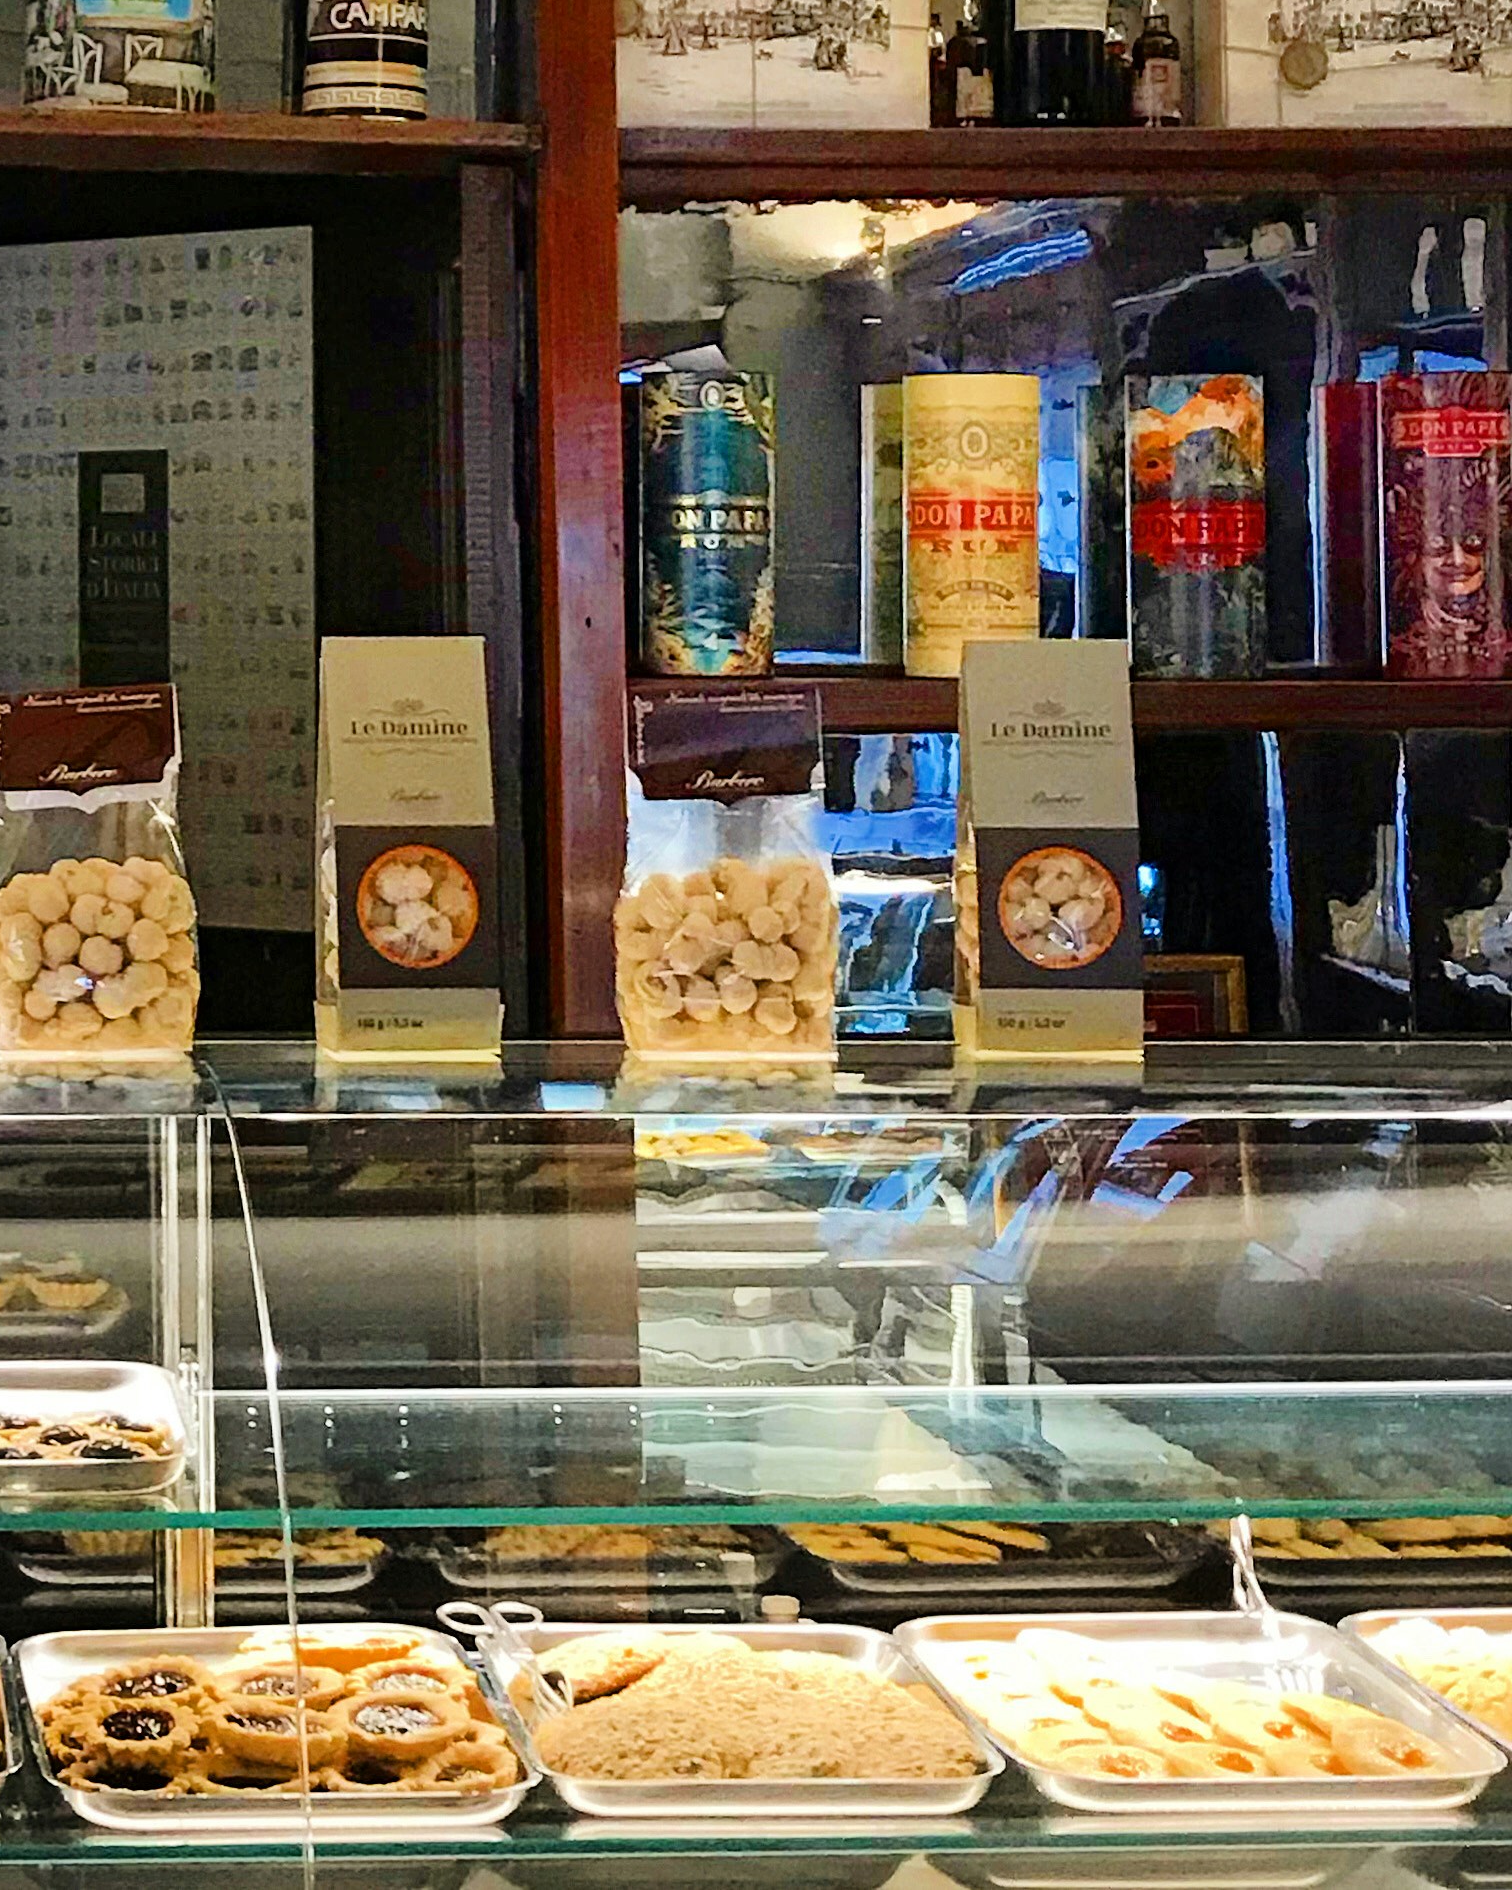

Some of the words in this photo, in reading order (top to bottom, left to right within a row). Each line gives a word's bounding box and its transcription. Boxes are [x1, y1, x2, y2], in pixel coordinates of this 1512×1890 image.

[1408, 420, 1447, 436] DON
[1452, 419, 1498, 435] PAPA
[914, 503, 962, 526] DON
[974, 504, 1034, 526] PAPA
[381, 718, 469, 737] Damine
[1022, 719, 1112, 739] Damine
